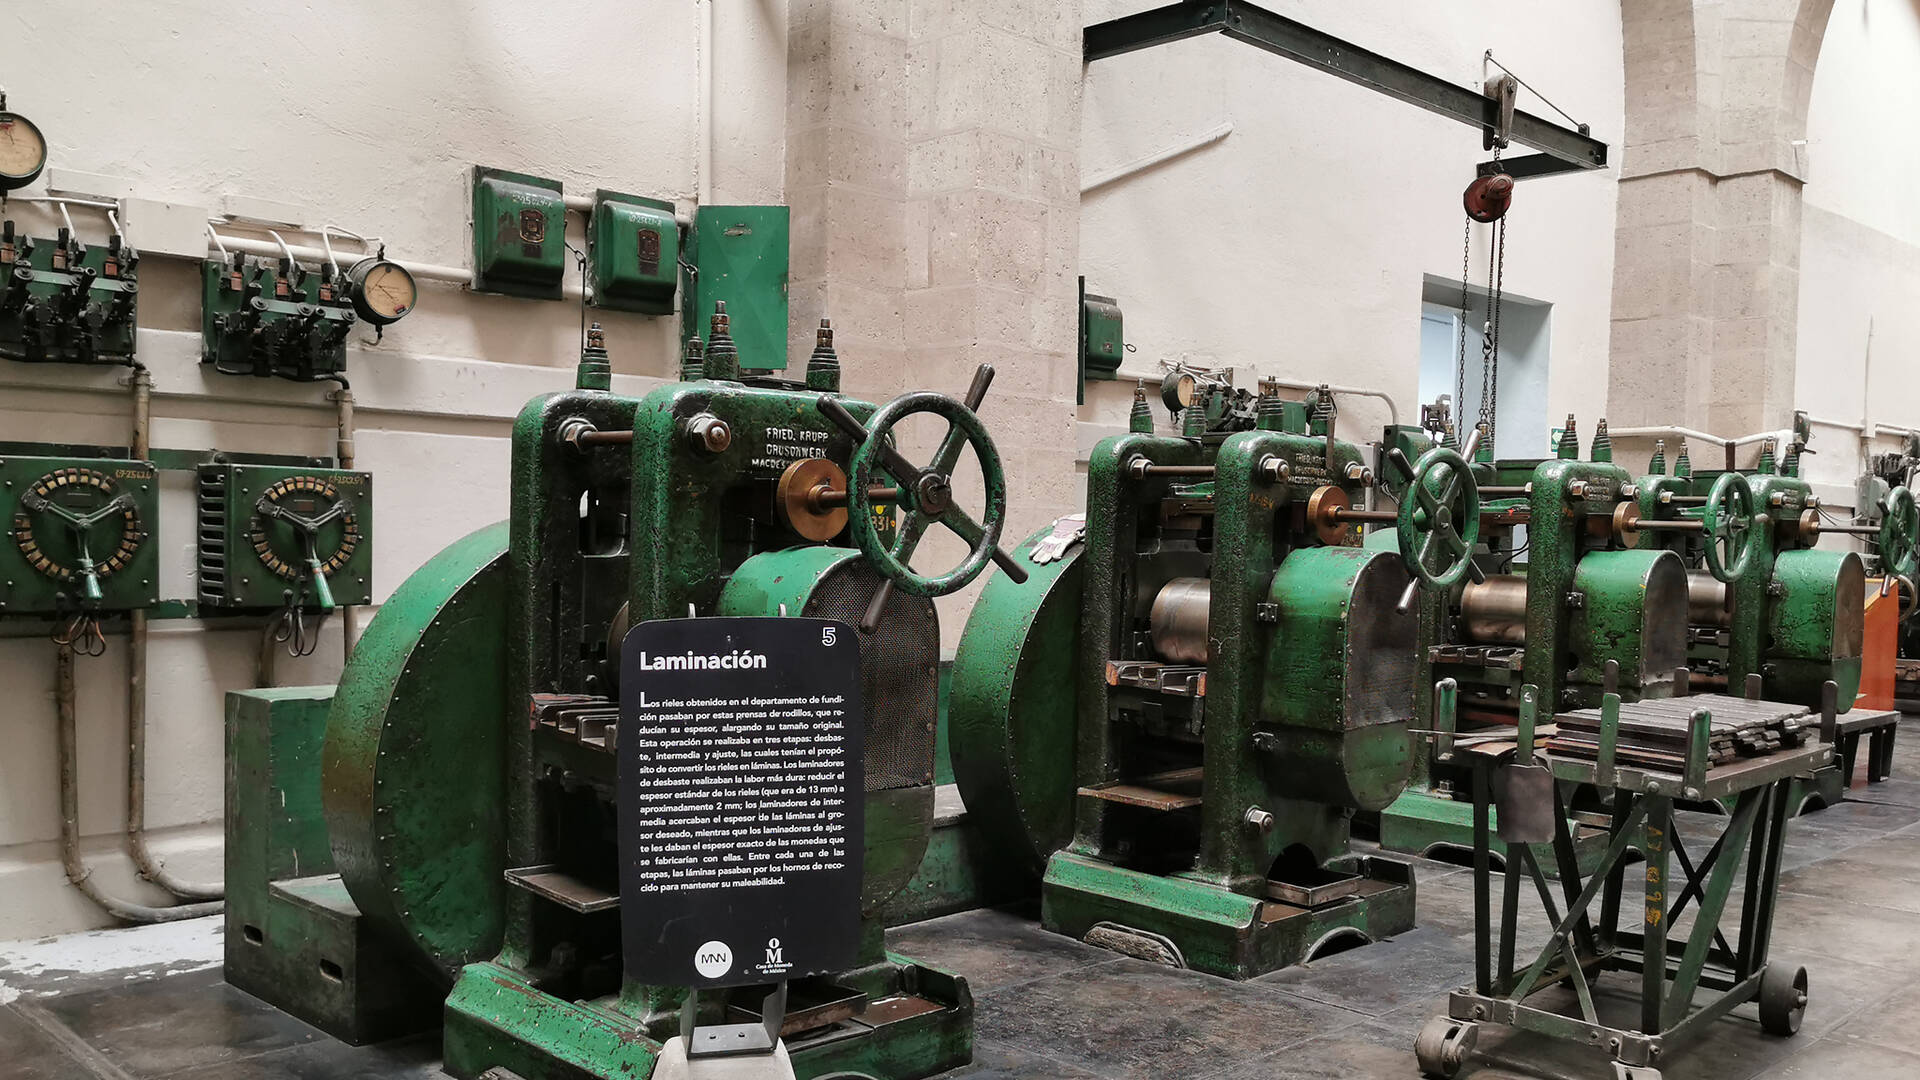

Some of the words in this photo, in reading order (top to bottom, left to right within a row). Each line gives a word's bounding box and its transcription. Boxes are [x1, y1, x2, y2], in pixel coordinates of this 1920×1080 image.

[766, 428, 796, 441] FRIED.
[800, 430, 829, 442] KRUPP
[822, 627, 836, 646] 5
[640, 650, 767, 671] Laminación
[640, 691, 660, 708] Los
[662, 699, 684, 707] rieles
[686, 697, 727, 707] obtenidos
[741, 697, 749, 706] el
[750, 697, 808, 707] departamento
[809, 695, 820, 704] de
[821, 695, 845, 704] fundi-
[639, 713, 657, 721] ción
[659, 711, 694, 722] pasaban
[695, 713, 711, 722] por
[736, 712, 767, 721] prensas
[769, 709, 781, 718] de
[782, 709, 814, 718] rodillos,
[815, 710, 831, 718] que
[684, 726, 718, 735] espesor,
[722, 722, 762, 734] alargando
[778, 722, 809, 730] tamaño
[812, 720, 844, 731] original.
[639, 739, 658, 747] Esta
[659, 738, 701, 749] operación
[714, 736, 751, 745] realizaba
[782, 736, 812, 745] etapas:
[814, 733, 845, 742] desbas-
[656, 750, 700, 760] intermedia
[704, 752, 710, 761] y
[712, 750, 739, 760] ajuste,
[741, 749, 752, 757] las
[754, 748, 779, 757] cuales
[780, 747, 806, 756] tenían
[807, 746, 816, 755] el
[817, 746, 845, 757] propó-
[640, 765, 655, 774] sito
[656, 765, 667, 773] de
[668, 764, 704, 773] convertir
[704, 763, 716, 771] los
[717, 762, 739, 771] rieles
[751, 761, 782, 770] láminas.
[798, 759, 845, 768] laminadores
[639, 778, 651, 787] de
[652, 777, 690, 787] desbaste
[692, 775, 733, 785] realizaban
[735, 775, 743, 783] la
[744, 774, 765, 783] labor
[767, 774, 783, 782] más
[785, 773, 806, 782] dura:
[807, 772, 836, 781] reducir
[837, 771, 845, 780] el
[674, 789, 710, 799] estándar
[711, 789, 723, 797] de
[724, 788, 736, 797] los
[738, 787, 760, 796] rieles
[761, 787, 779, 797] (que
[795, 785, 807, 794] de
[808, 785, 819, 793] 13
[820, 785, 838, 794] mm)
[640, 804, 714, 814] aproximadamente
[716, 802, 722, 810] 2
[745, 800, 757, 809] los
[758, 799, 808, 809] laminadores
[810, 798, 821, 806] de
[640, 817, 666, 826] media
[668, 816, 711, 825] acercaban
[713, 814, 721, 823] el
[723, 815, 756, 825] espesor
[758, 812, 769, 821] de
[771, 812, 783, 821] las
[785, 811, 816, 820] láminas
[817, 810, 825, 819] al
[827, 812, 845, 820] gro-
[655, 829, 693, 839] deseado,
[695, 828, 730, 837] mientras
[731, 829, 748, 837] que
[749, 826, 762, 835] los
[763, 824, 811, 834] laminadores
[812, 823, 824, 832] de
[825, 823, 845, 833] ajus-
[651, 844, 663, 852] les
[664, 843, 691, 852] daban
[692, 841, 700, 850] el
[701, 842, 735, 852] espesor
[736, 840, 764, 848] exacto
[765, 838, 777, 847] de
[778, 838, 790, 846] las
[791, 836, 828, 846] monedas
[829, 837, 845, 846] que
[654, 855, 698, 865] fabricarían
[723, 853, 744, 862] ellas.
[748, 852, 770, 861] Entre
[775, 850, 794, 859] cada
[818, 848, 829, 857] de
[833, 848, 845, 856] las
[640, 871, 671, 881] etapas,
[672, 869, 684, 877] las
[685, 868, 716, 877] láminas
[718, 866, 752, 877] pasaban
[753, 866, 768, 876] por
[769, 864, 781, 872] los
[783, 863, 810, 872] hornos
[812, 862, 823, 870] de
[640, 883, 659, 892] cido
[660, 884, 679, 893] para
[680, 880, 720, 890] mantener
[732, 876, 785, 887] maleabilidad.
[701, 953, 726, 964] MNN
